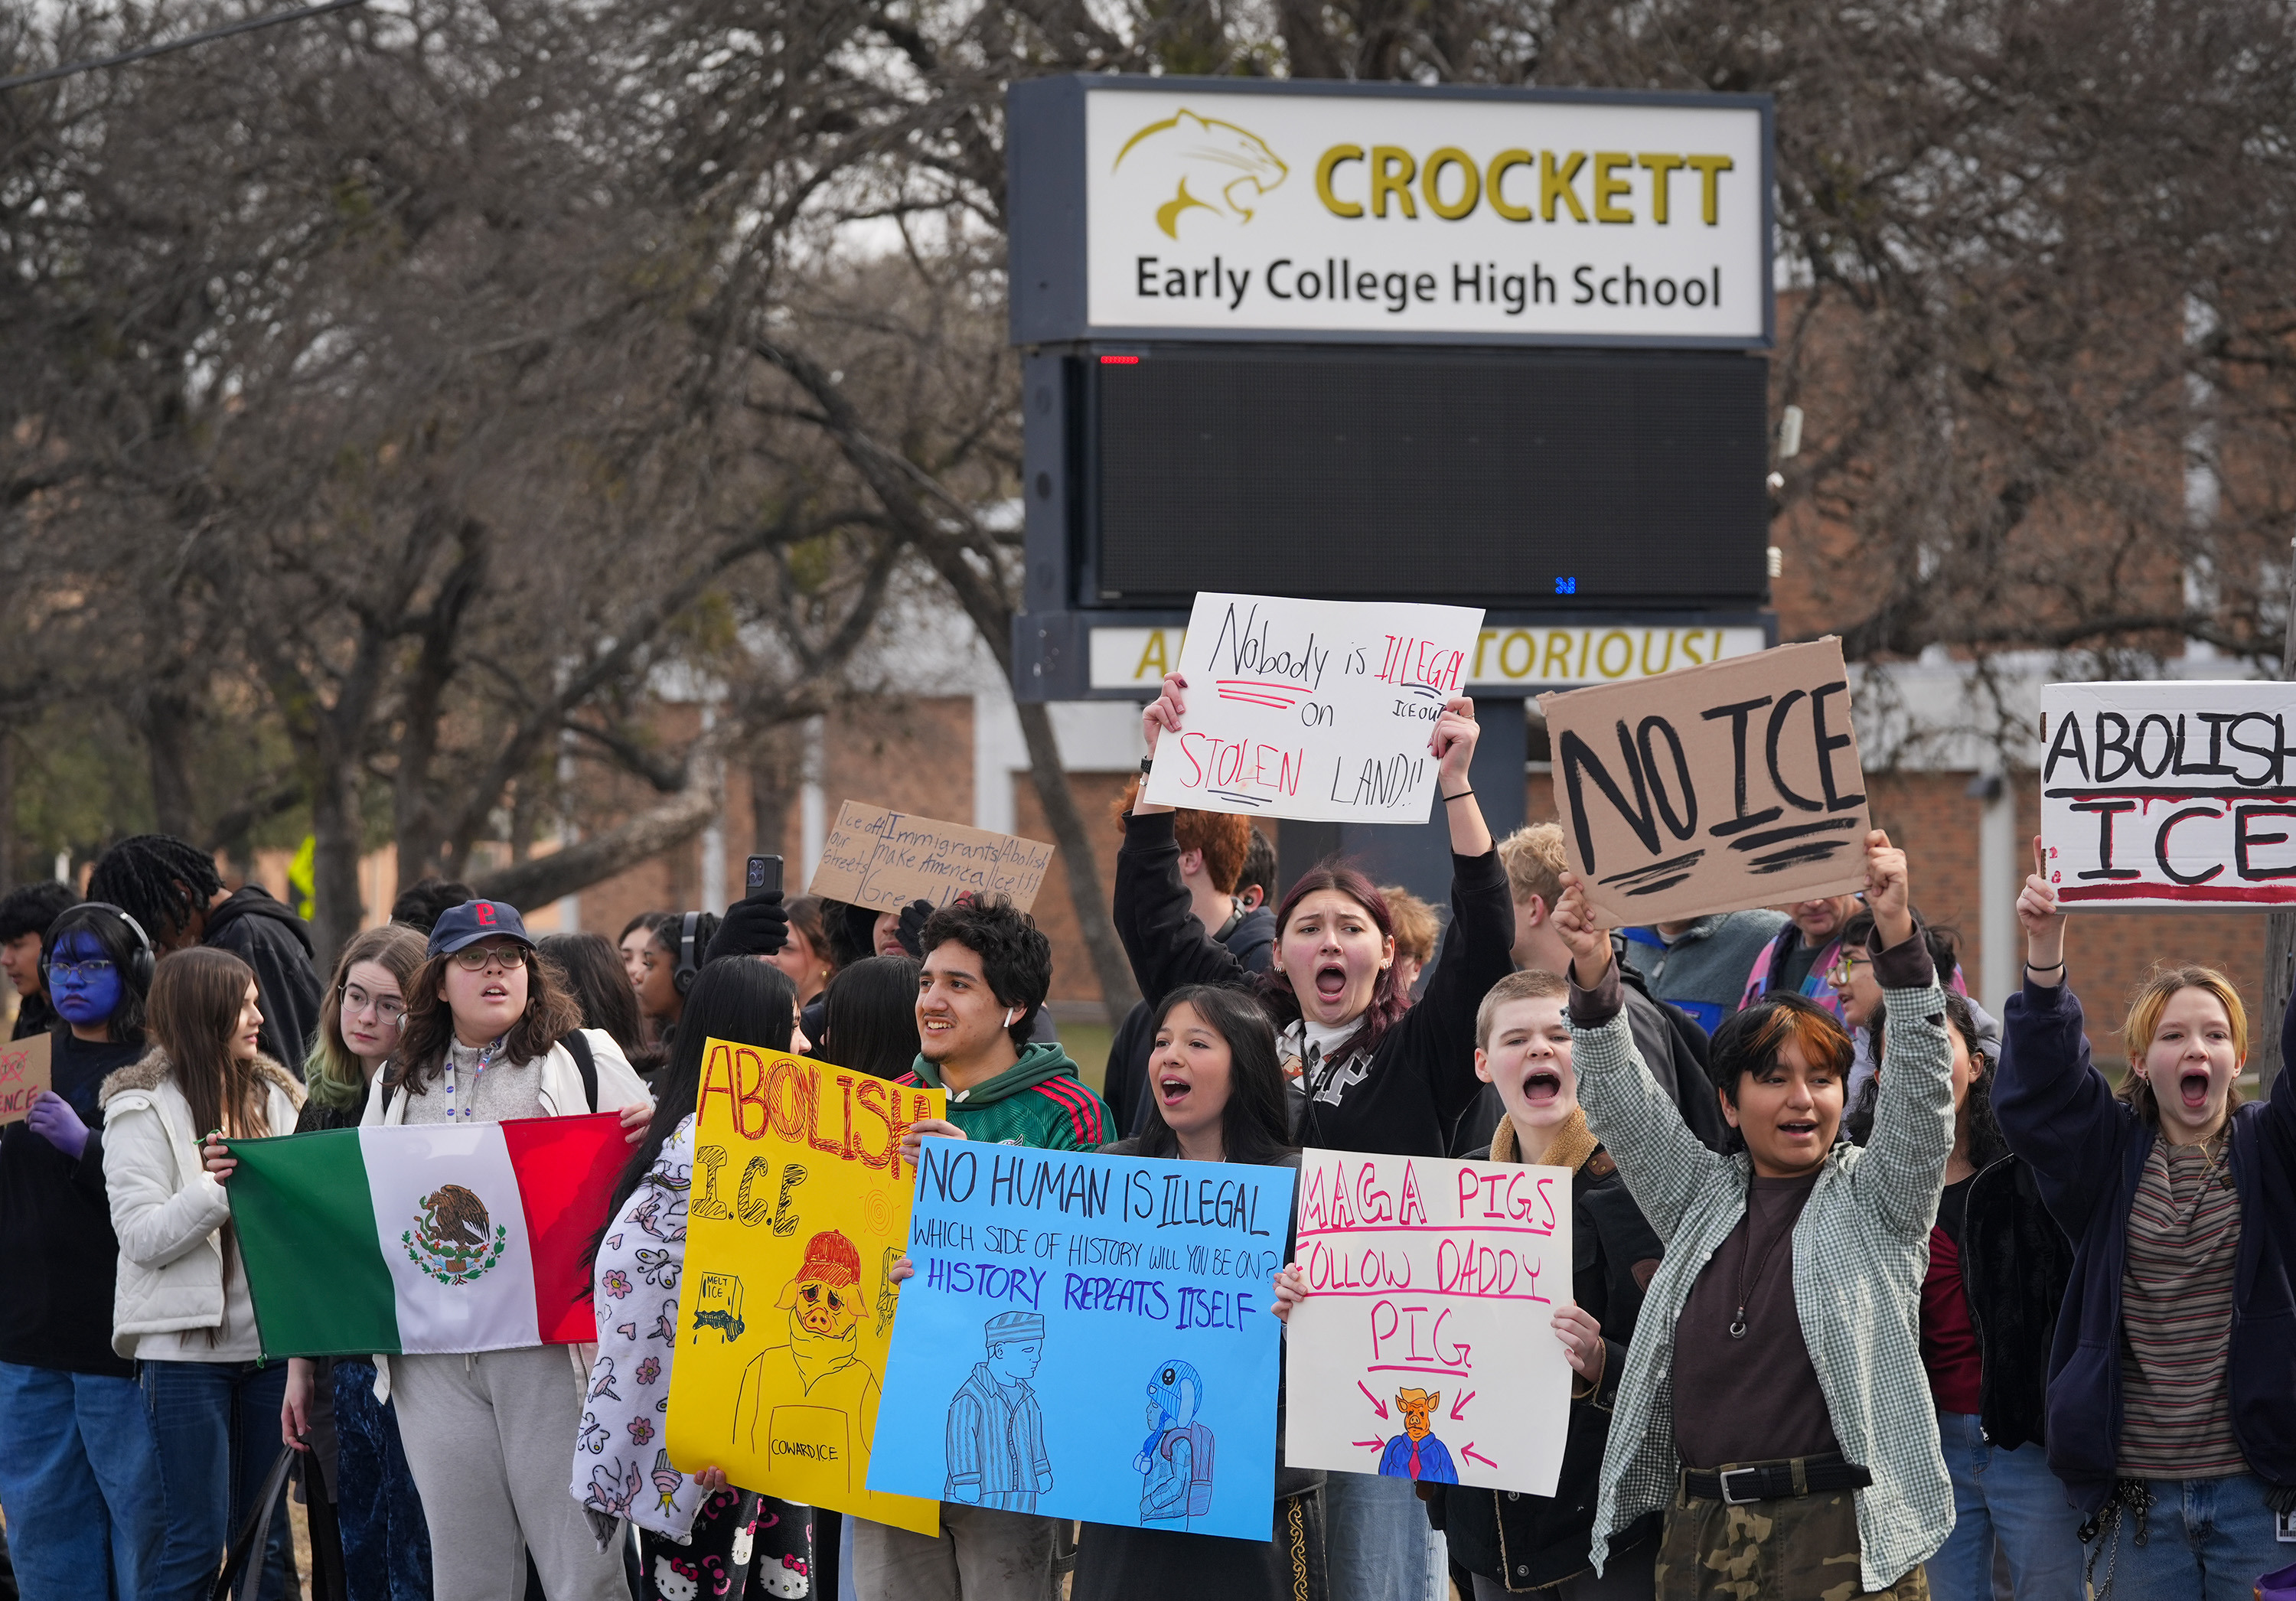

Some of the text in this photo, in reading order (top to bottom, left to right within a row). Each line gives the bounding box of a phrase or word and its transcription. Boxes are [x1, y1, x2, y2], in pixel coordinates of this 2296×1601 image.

[1315, 143, 1735, 226] CROCKETT
[1136, 257, 1722, 315] Early College High School
[1208, 602, 1464, 690] Nobody is ILLEGAL
[1472, 630, 1724, 680] TORIOUS!
[1301, 702, 1333, 727] on
[1392, 699, 1417, 718] ICE
[1179, 732, 1424, 808] STOLEN LAND!!
[1560, 680, 1866, 875] NO ICE
[840, 802, 885, 835] Ice off
[880, 813, 999, 862] Immigrants
[2069, 800, 2296, 886] ICE
[918, 853, 985, 886] America
[1000, 839, 1049, 870] Abolish
[697, 1044, 931, 1185] ABOLISH
[919, 1147, 1270, 1237] NO HUMAN IS ILLEGAL
[1299, 1159, 1556, 1231] MAGA PIGS
[706, 1276, 729, 1286] MELT
[913, 1214, 1279, 1284] WHICH SIDE OF HISTORY WILL YOU BE ON?
[1437, 1238, 1541, 1299] DADDY
[708, 1286, 723, 1299] ICE
[927, 1258, 1257, 1332] HISTORY REPEATS ITSELF
[1370, 1299, 1473, 1368] PIG
